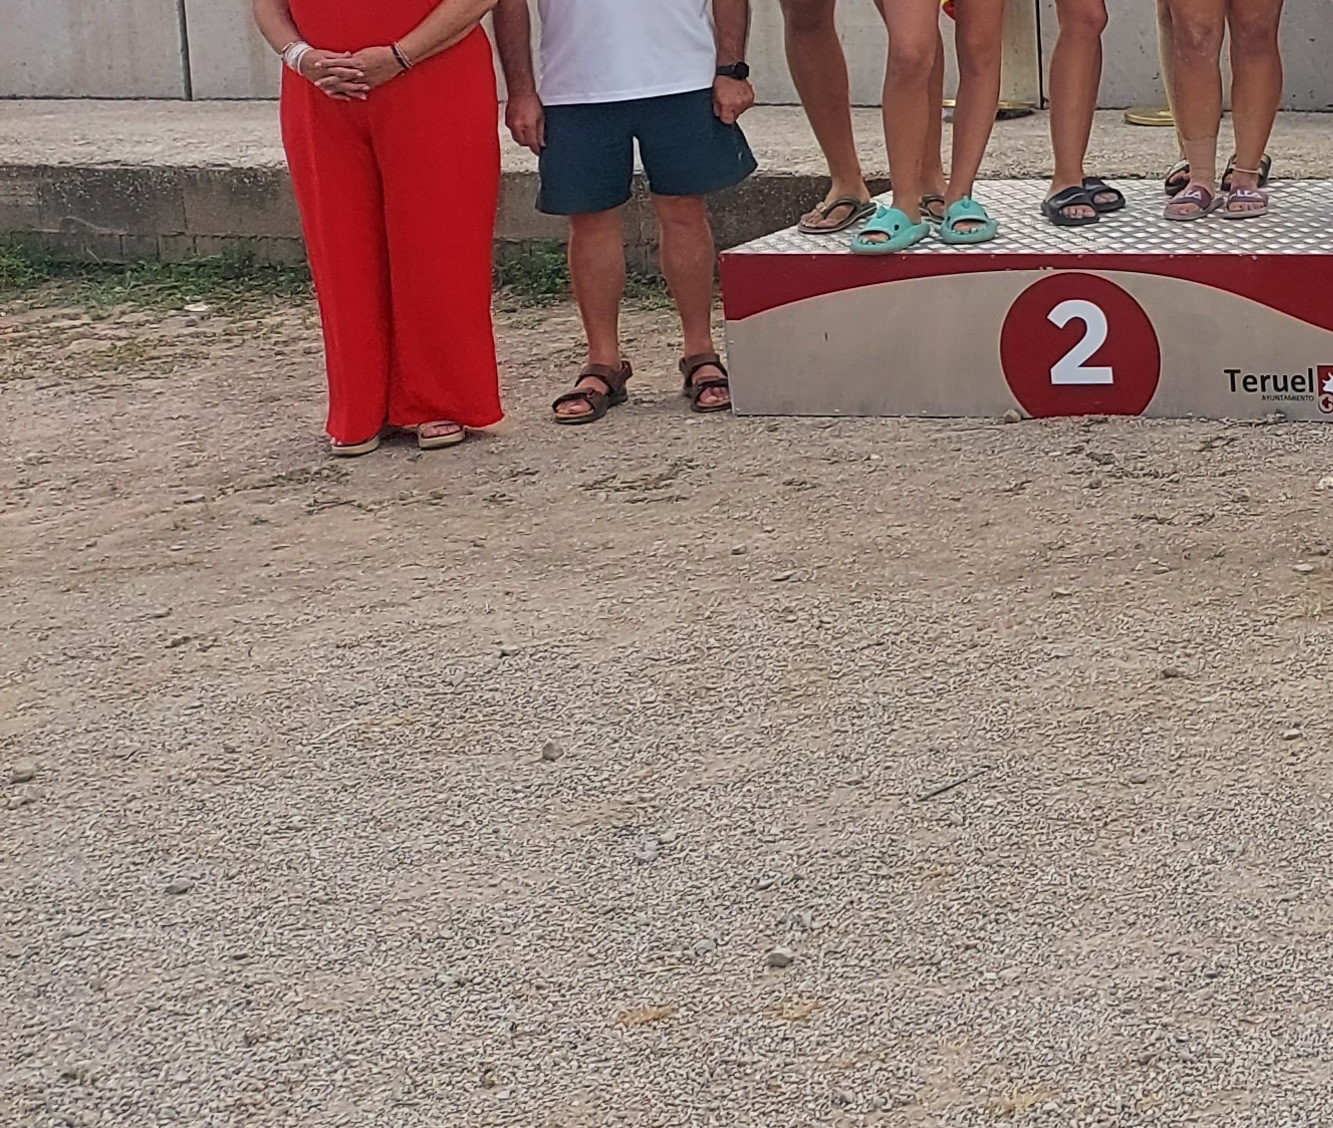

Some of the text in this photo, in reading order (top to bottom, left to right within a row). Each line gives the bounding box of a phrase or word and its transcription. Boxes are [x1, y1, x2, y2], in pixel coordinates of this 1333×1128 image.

[1046, 299, 1115, 385] 2
[1223, 367, 1315, 393] Teruel
[1261, 394, 1315, 402] AYUNTAMIENTO
